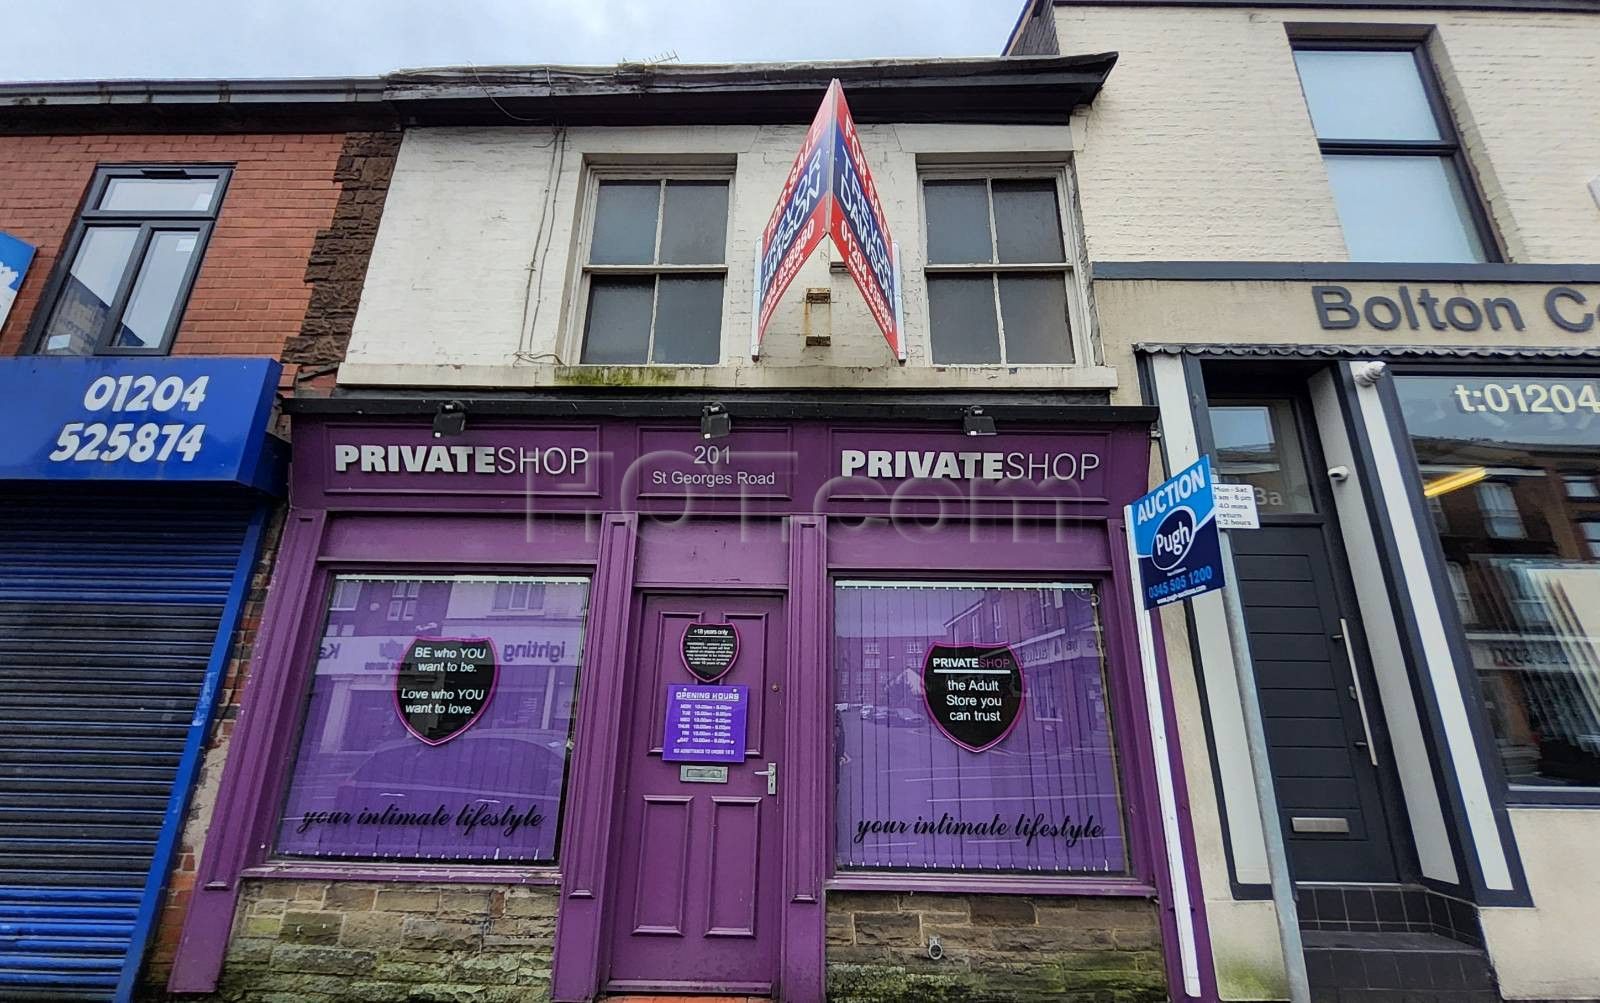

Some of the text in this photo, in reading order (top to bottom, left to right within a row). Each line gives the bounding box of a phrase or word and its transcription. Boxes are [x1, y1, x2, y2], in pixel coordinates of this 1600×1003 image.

[763, 148, 821, 275] TREVOR
[842, 145, 893, 286] TREVOR
[761, 170, 820, 301] DAWSON
[841, 174, 893, 309] DAWSON
[841, 220, 867, 281] 01204
[1312, 285, 1600, 332] Bolton C
[84, 375, 209, 412] 01204
[49, 423, 206, 462] 525874
[693, 445, 730, 465] 201
[652, 471, 775, 487] St Georges Road
[1137, 464, 1205, 526] AUCTION
[1155, 521, 1190, 556] Pugh
[1148, 581, 1168, 599] 0345
[1169, 575, 1187, 591] 505
[1188, 565, 1213, 585] 1200
[414, 647, 486, 659] BE who YOU
[418, 662, 444, 672] want
[446, 662, 458, 672] to
[460, 662, 477, 672] be.
[401, 688, 484, 700] Love who YOU
[946, 694, 1002, 709] Store you
[947, 680, 999, 691] the Adult
[405, 704, 474, 714] want to love.
[949, 710, 1001, 721] can trust
[296, 803, 545, 837] your intimate lifestyle
[854, 812, 1105, 848] your intimate lifestyle
